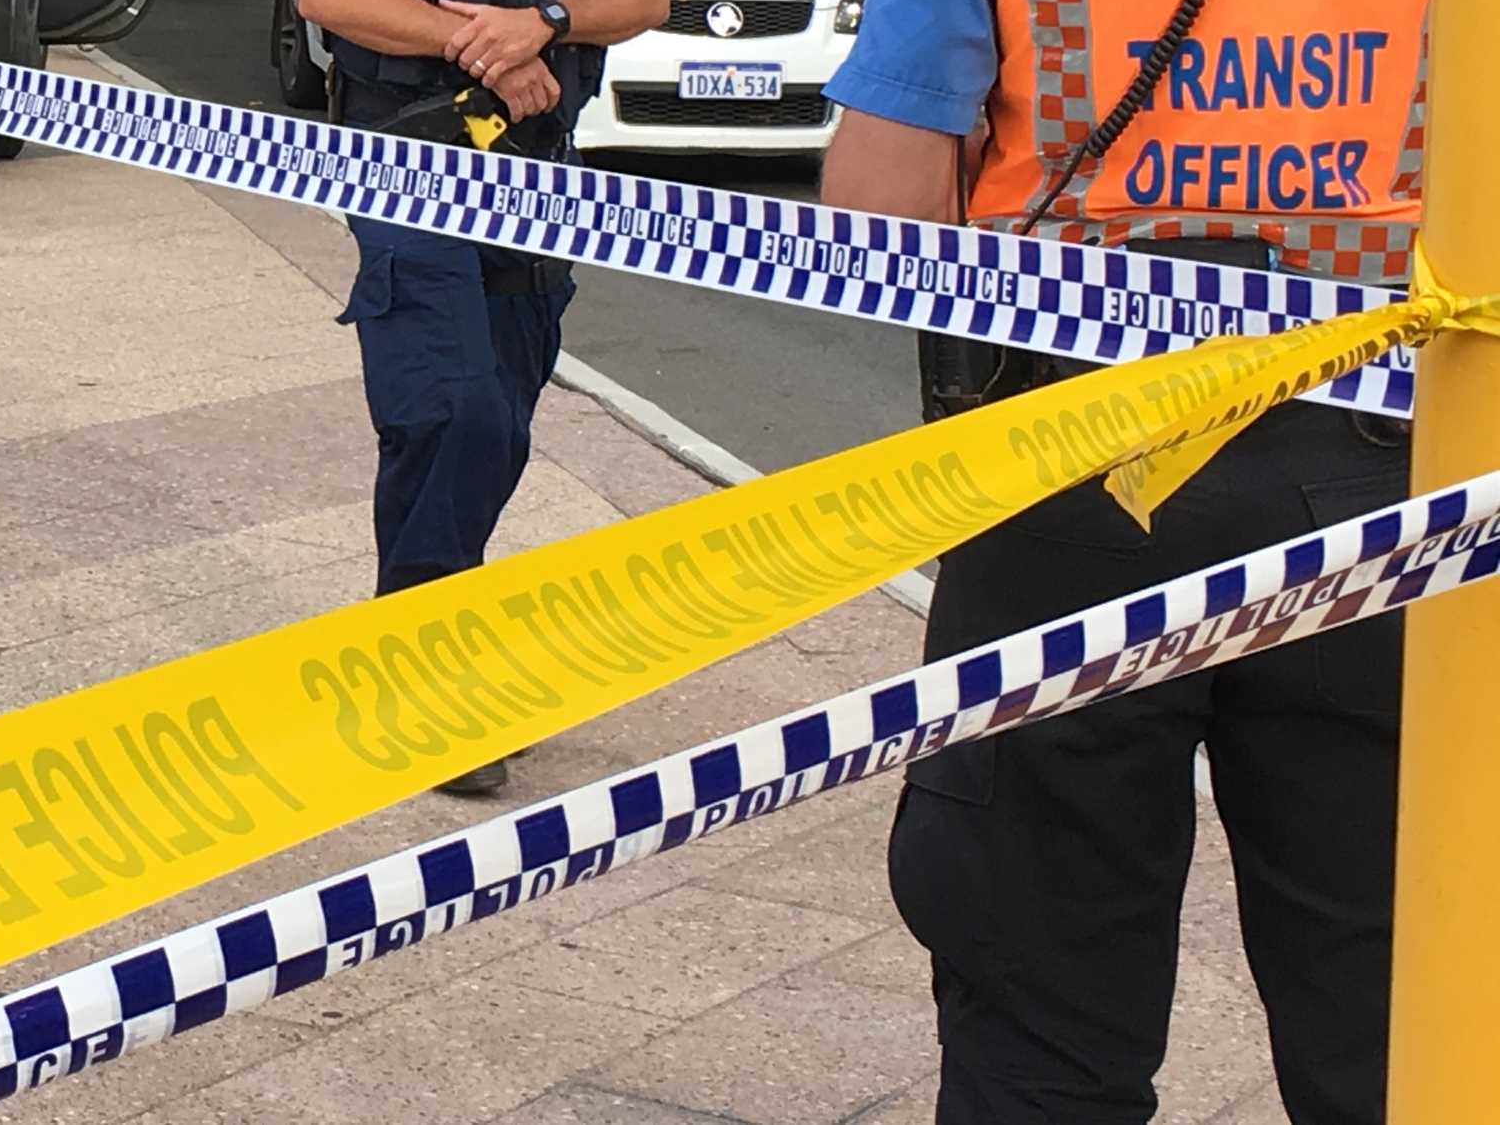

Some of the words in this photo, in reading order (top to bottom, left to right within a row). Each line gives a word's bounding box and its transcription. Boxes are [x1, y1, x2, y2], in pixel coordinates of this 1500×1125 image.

[687, 74, 735, 96] 1DXA
[744, 75, 778, 97] 534
[1127, 31, 1389, 111] TRANSIT
[177, 125, 237, 157] POLICE
[283, 146, 348, 181] POLICE
[369, 164, 442, 199] POLICE
[1125, 138, 1372, 211] OFFICER
[495, 187, 578, 224] POLICE
[606, 205, 693, 246] POLICE
[764, 233, 863, 279] POLICE
[902, 256, 1014, 303] POLICE
[1109, 291, 1244, 337] POLICE
[1121, 572, 1346, 672] POLICE
